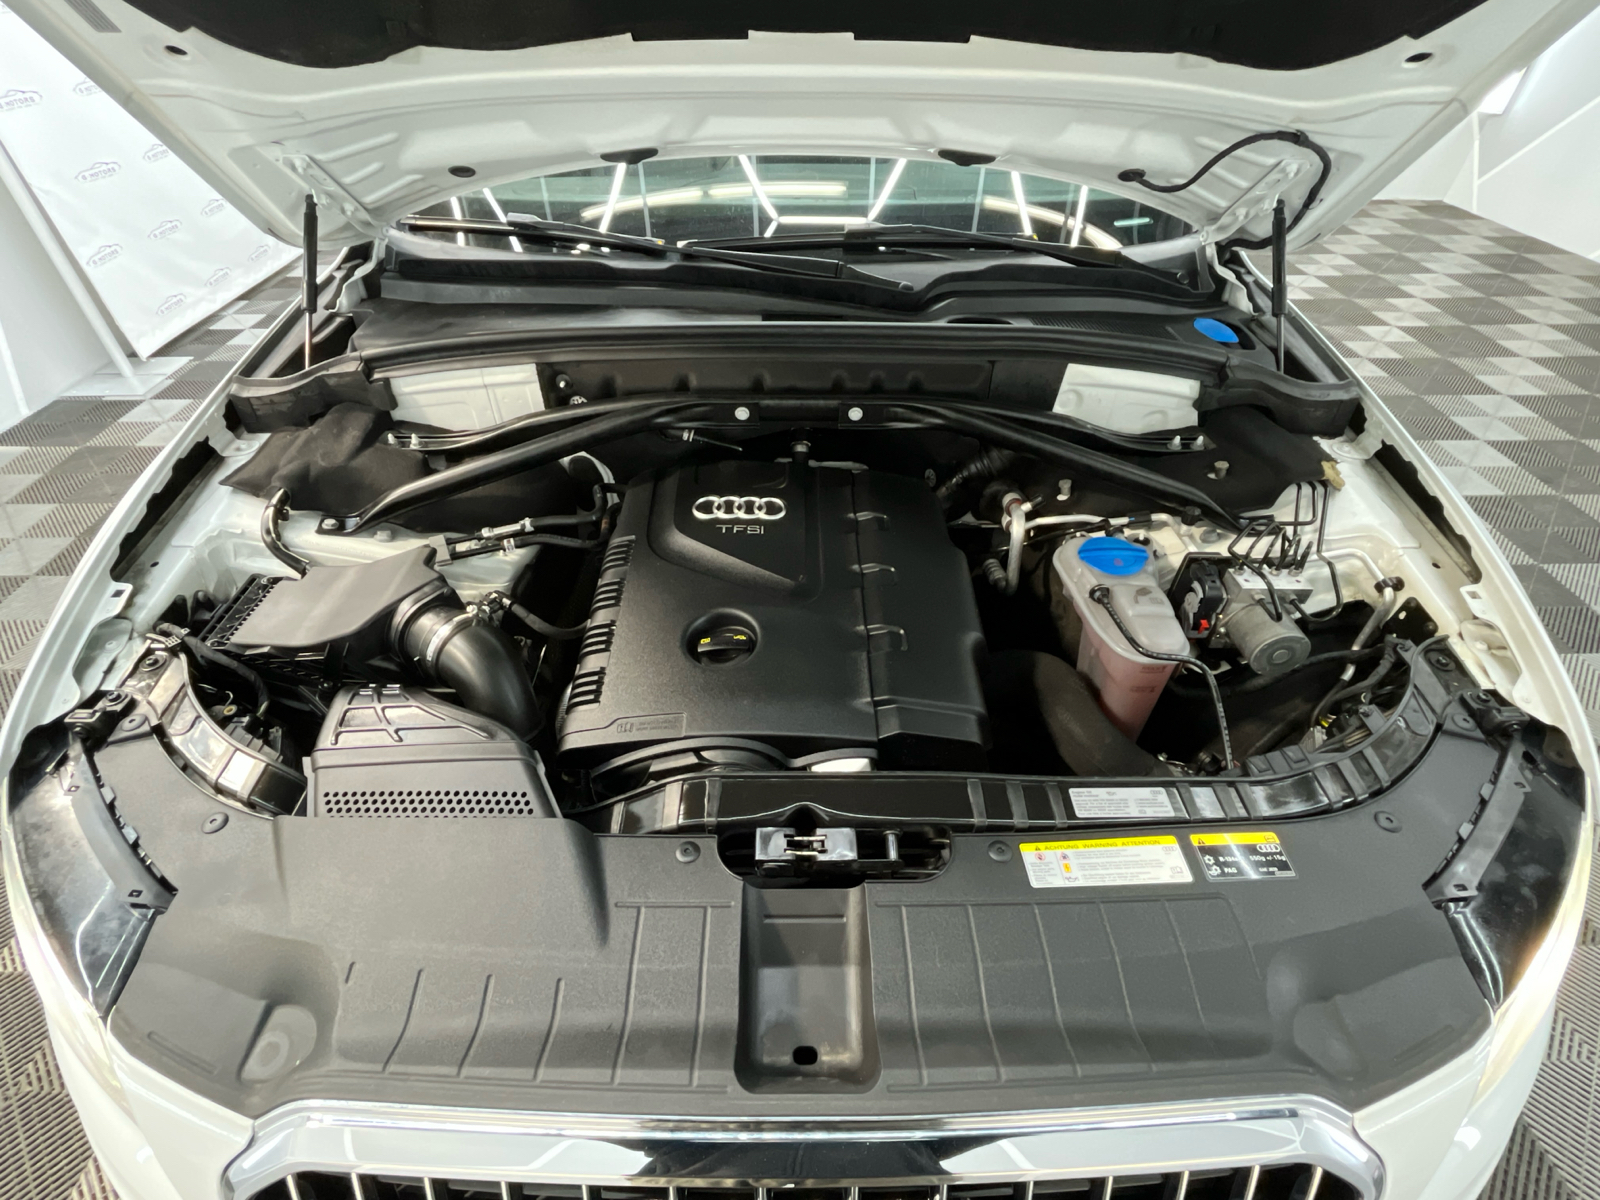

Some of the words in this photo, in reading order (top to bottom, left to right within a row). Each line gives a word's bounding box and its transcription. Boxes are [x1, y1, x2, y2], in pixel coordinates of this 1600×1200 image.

[4, 96, 36, 107] MOTORS
[88, 166, 117, 179] MOTORS
[97, 248, 119, 262] MOTORS
[716, 524, 764, 535] TFSI
[1044, 843, 1079, 851] ACHTUNG
[1082, 841, 1118, 849] WARNING
[1121, 839, 1161, 847] ATTENTION
